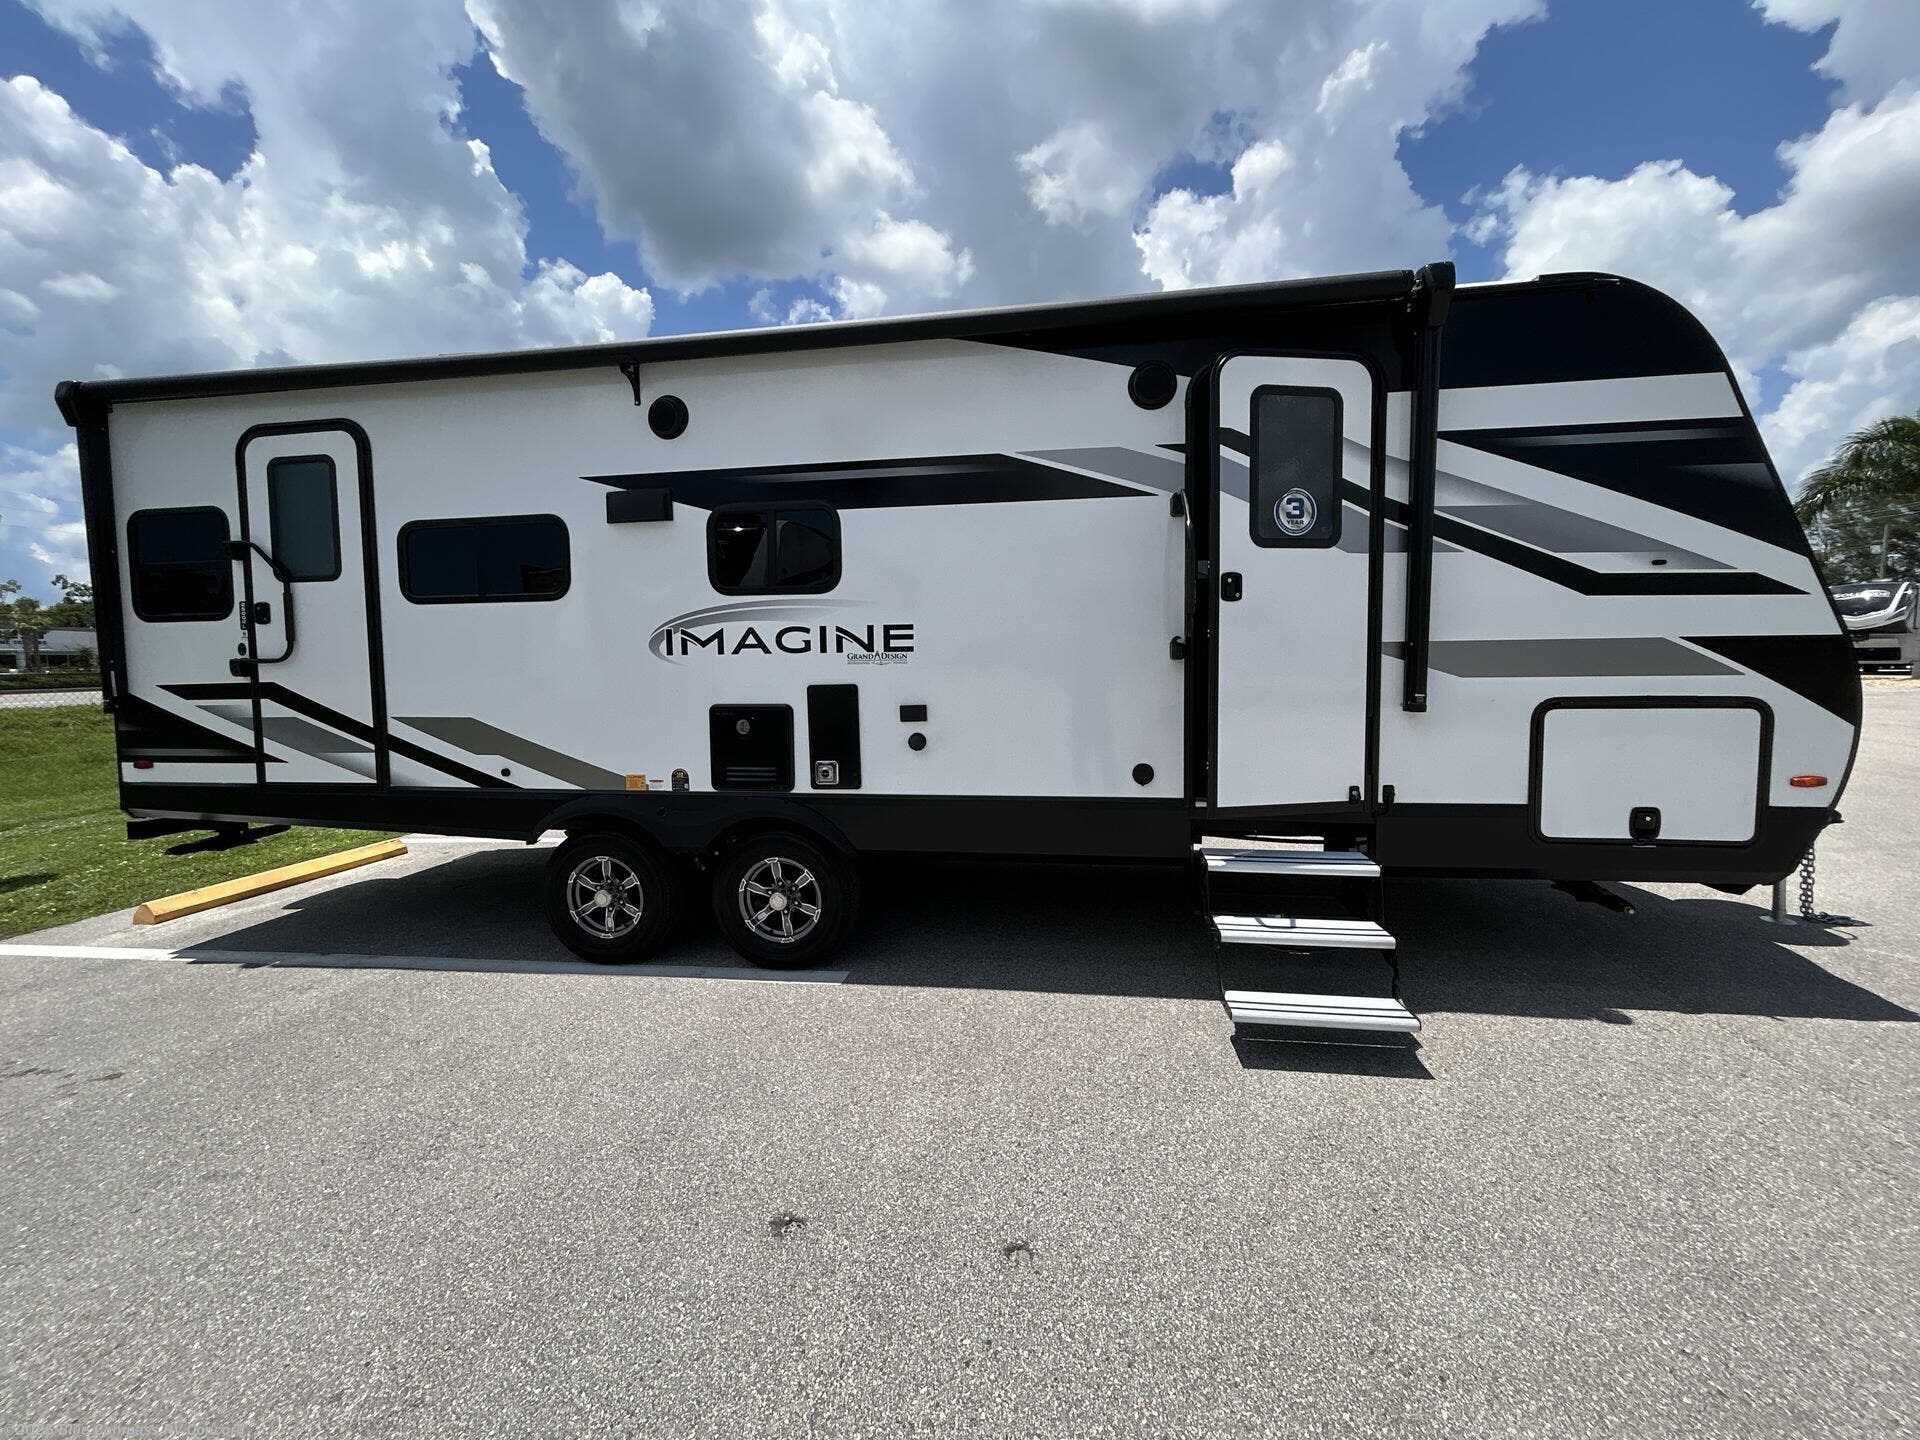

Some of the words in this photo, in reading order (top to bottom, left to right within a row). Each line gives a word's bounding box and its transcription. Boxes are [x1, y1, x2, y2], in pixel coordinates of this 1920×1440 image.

[1286, 497, 1305, 519] 3
[664, 624, 914, 656] IMAGINE
[847, 652, 874, 660] GRAND
[881, 652, 908, 660] DESIGN
